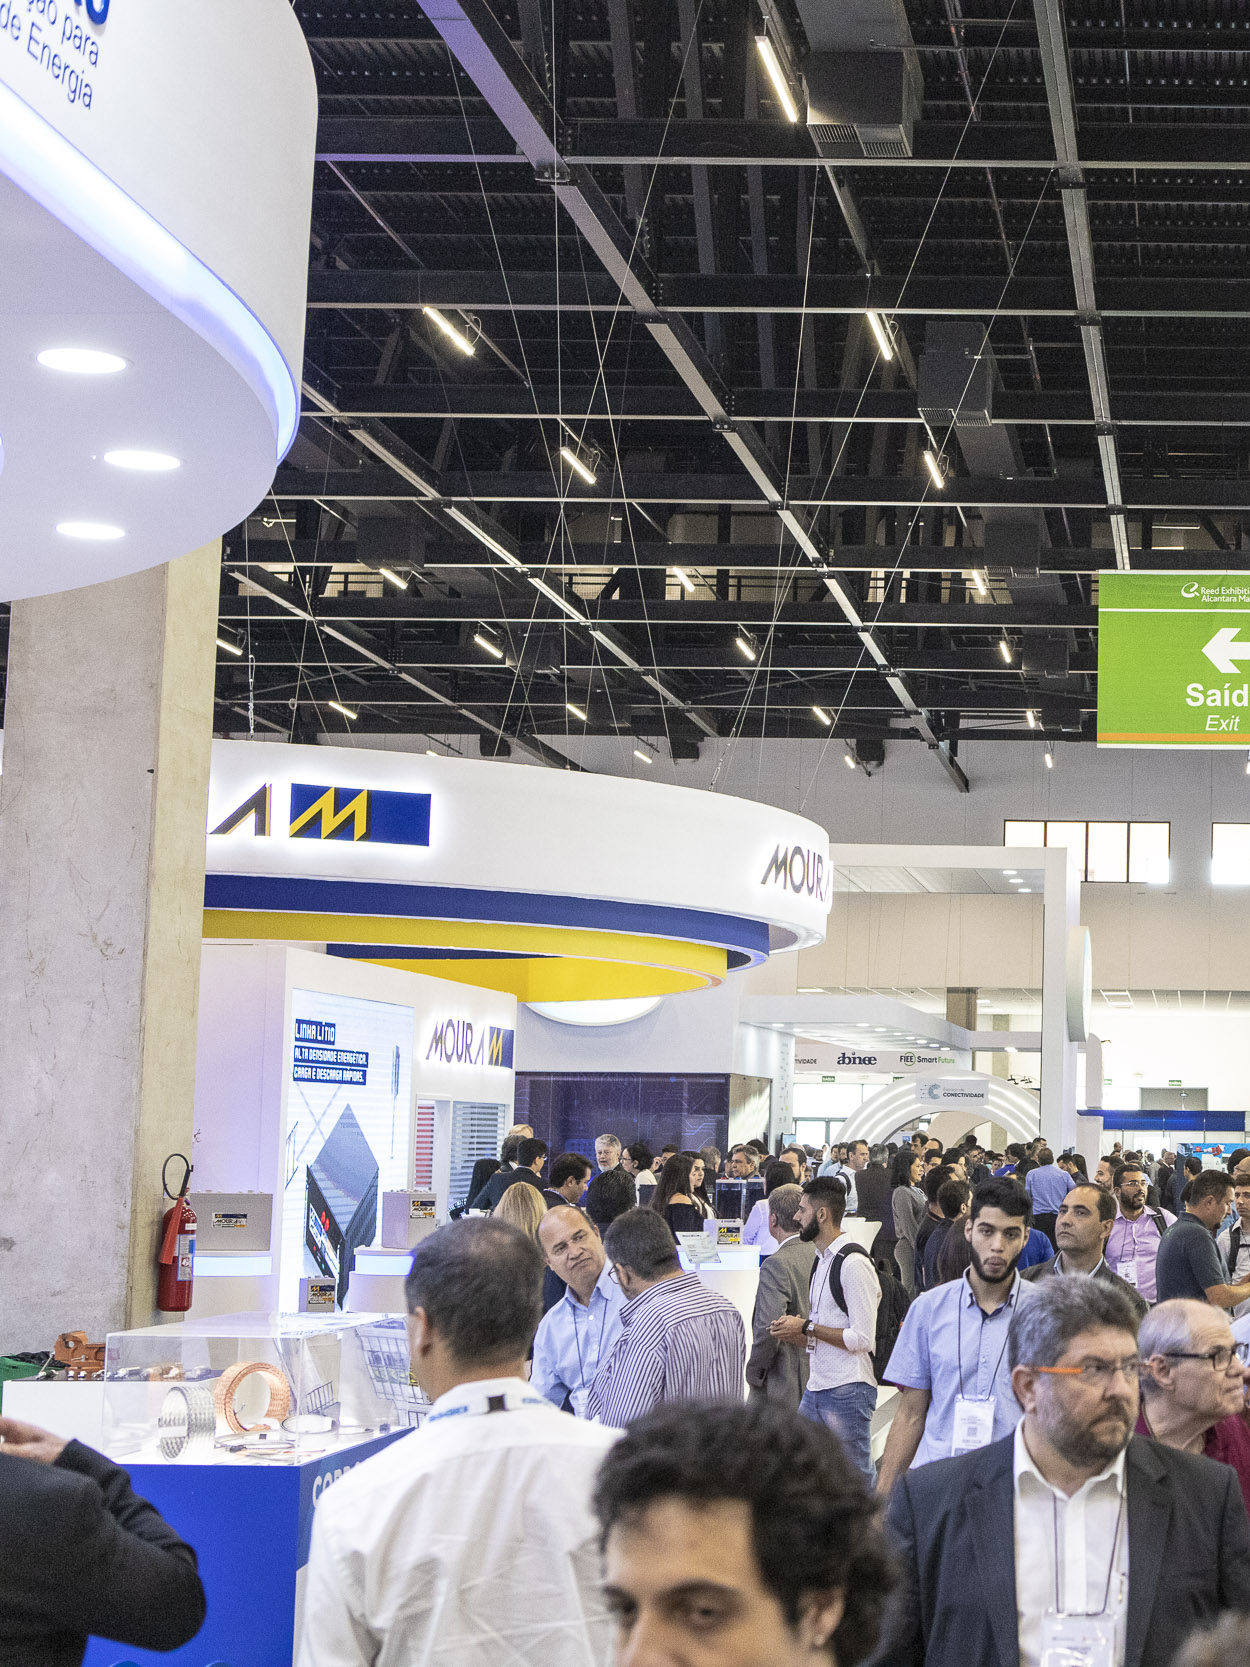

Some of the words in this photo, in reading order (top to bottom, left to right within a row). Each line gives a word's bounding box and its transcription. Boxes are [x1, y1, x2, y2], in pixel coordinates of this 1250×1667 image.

[61, 14, 99, 68] para
[27, 21, 93, 110] Energia
[1201, 586, 1220, 595] Reed
[1201, 595, 1237, 603] Alcantara
[1205, 715, 1241, 731] Exit
[295, 1023, 317, 1040] LINHA
[426, 1019, 485, 1065] MOURA
[294, 1047, 309, 1059] ALTA
[309, 1048, 337, 1063] DENSIDADE
[837, 1051, 877, 1066] abinee
[900, 1055, 914, 1064] FIEE
[917, 1056, 937, 1064] Smart
